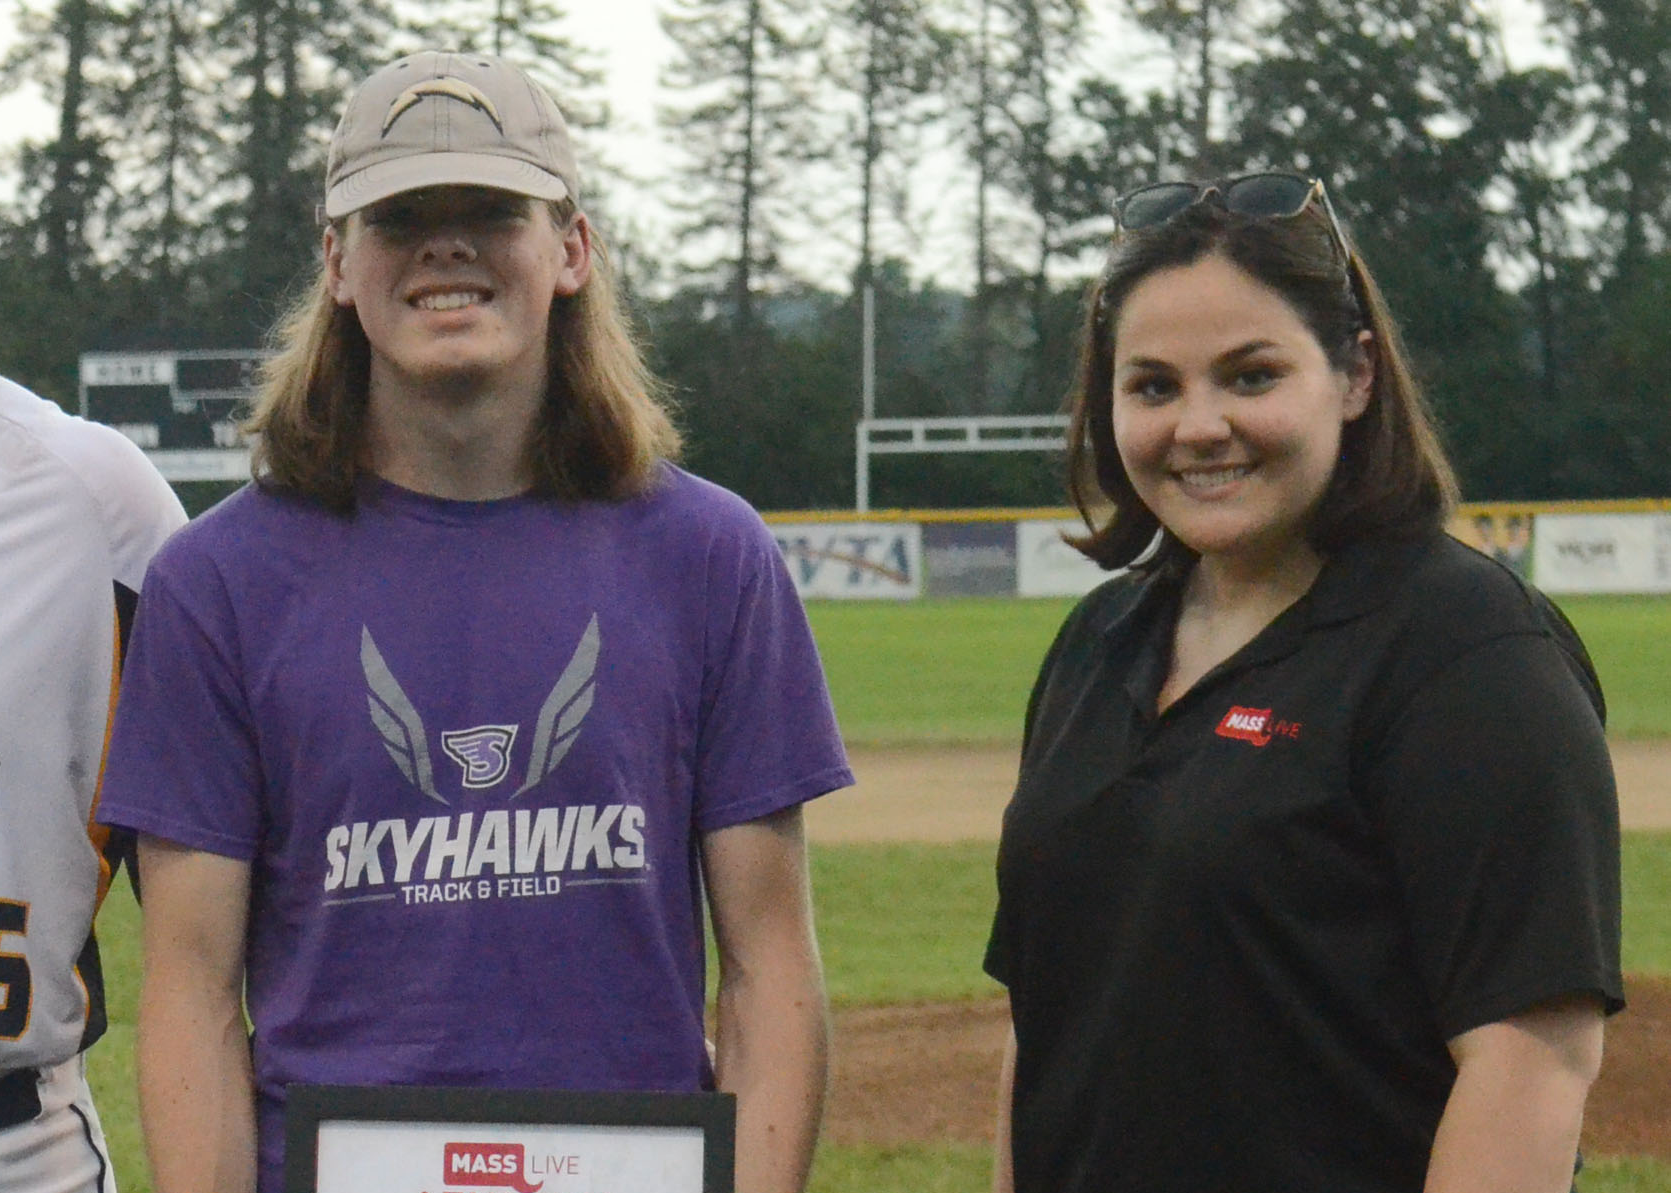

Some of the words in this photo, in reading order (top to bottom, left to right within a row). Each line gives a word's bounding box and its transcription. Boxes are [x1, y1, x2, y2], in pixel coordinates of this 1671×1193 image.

[1226, 713, 1266, 732] MASS
[324, 804, 647, 892] SKYHAWKS
[401, 881, 473, 905] TRACK
[477, 881, 492, 900] &
[497, 876, 561, 898] FIELD
[451, 1152, 518, 1174] MASS
[531, 1155, 580, 1175] LIVE
